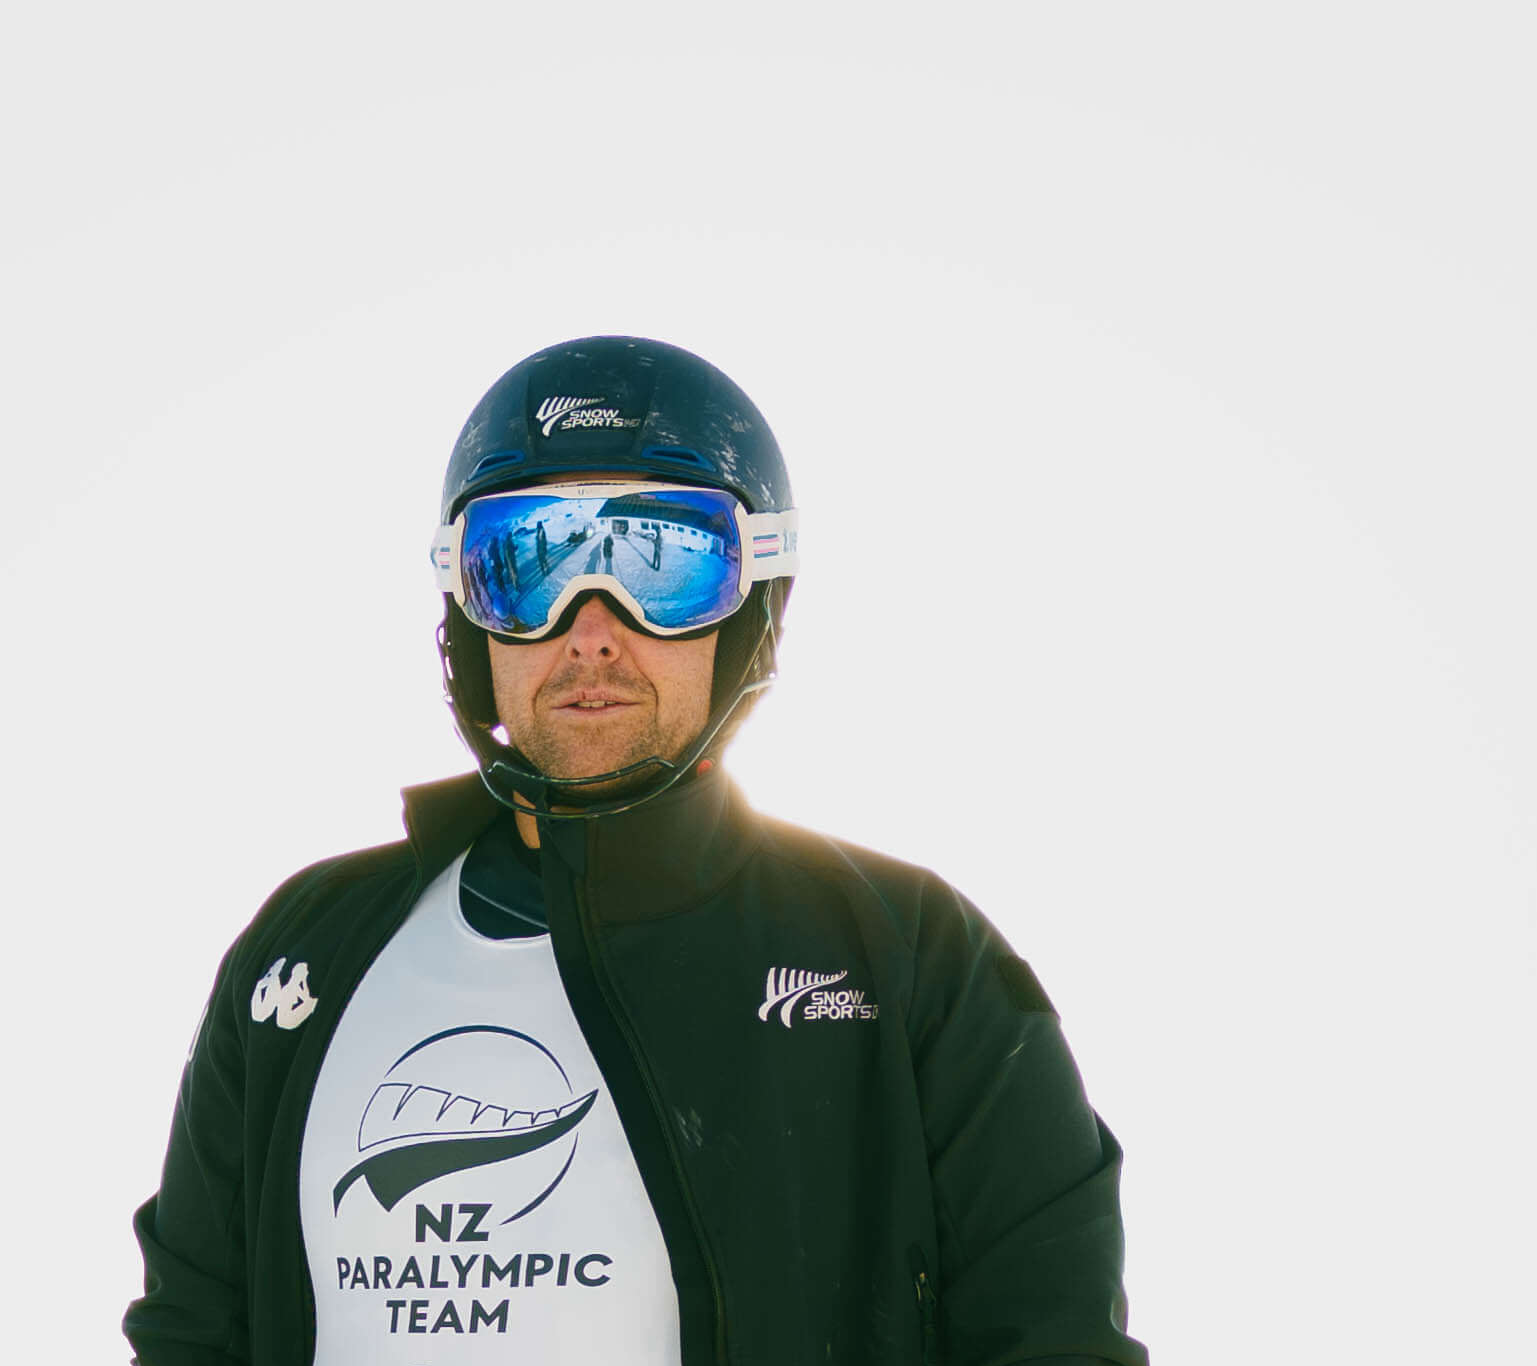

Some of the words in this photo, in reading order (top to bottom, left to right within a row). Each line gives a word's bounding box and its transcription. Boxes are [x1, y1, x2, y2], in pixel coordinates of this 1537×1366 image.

[569, 408, 620, 418] SNOW
[810, 989, 865, 1006] SNOW
[415, 1203, 493, 1243] NZ
[336, 1253, 614, 1290] PARALYMPIC
[385, 1299, 510, 1334] TEAM
